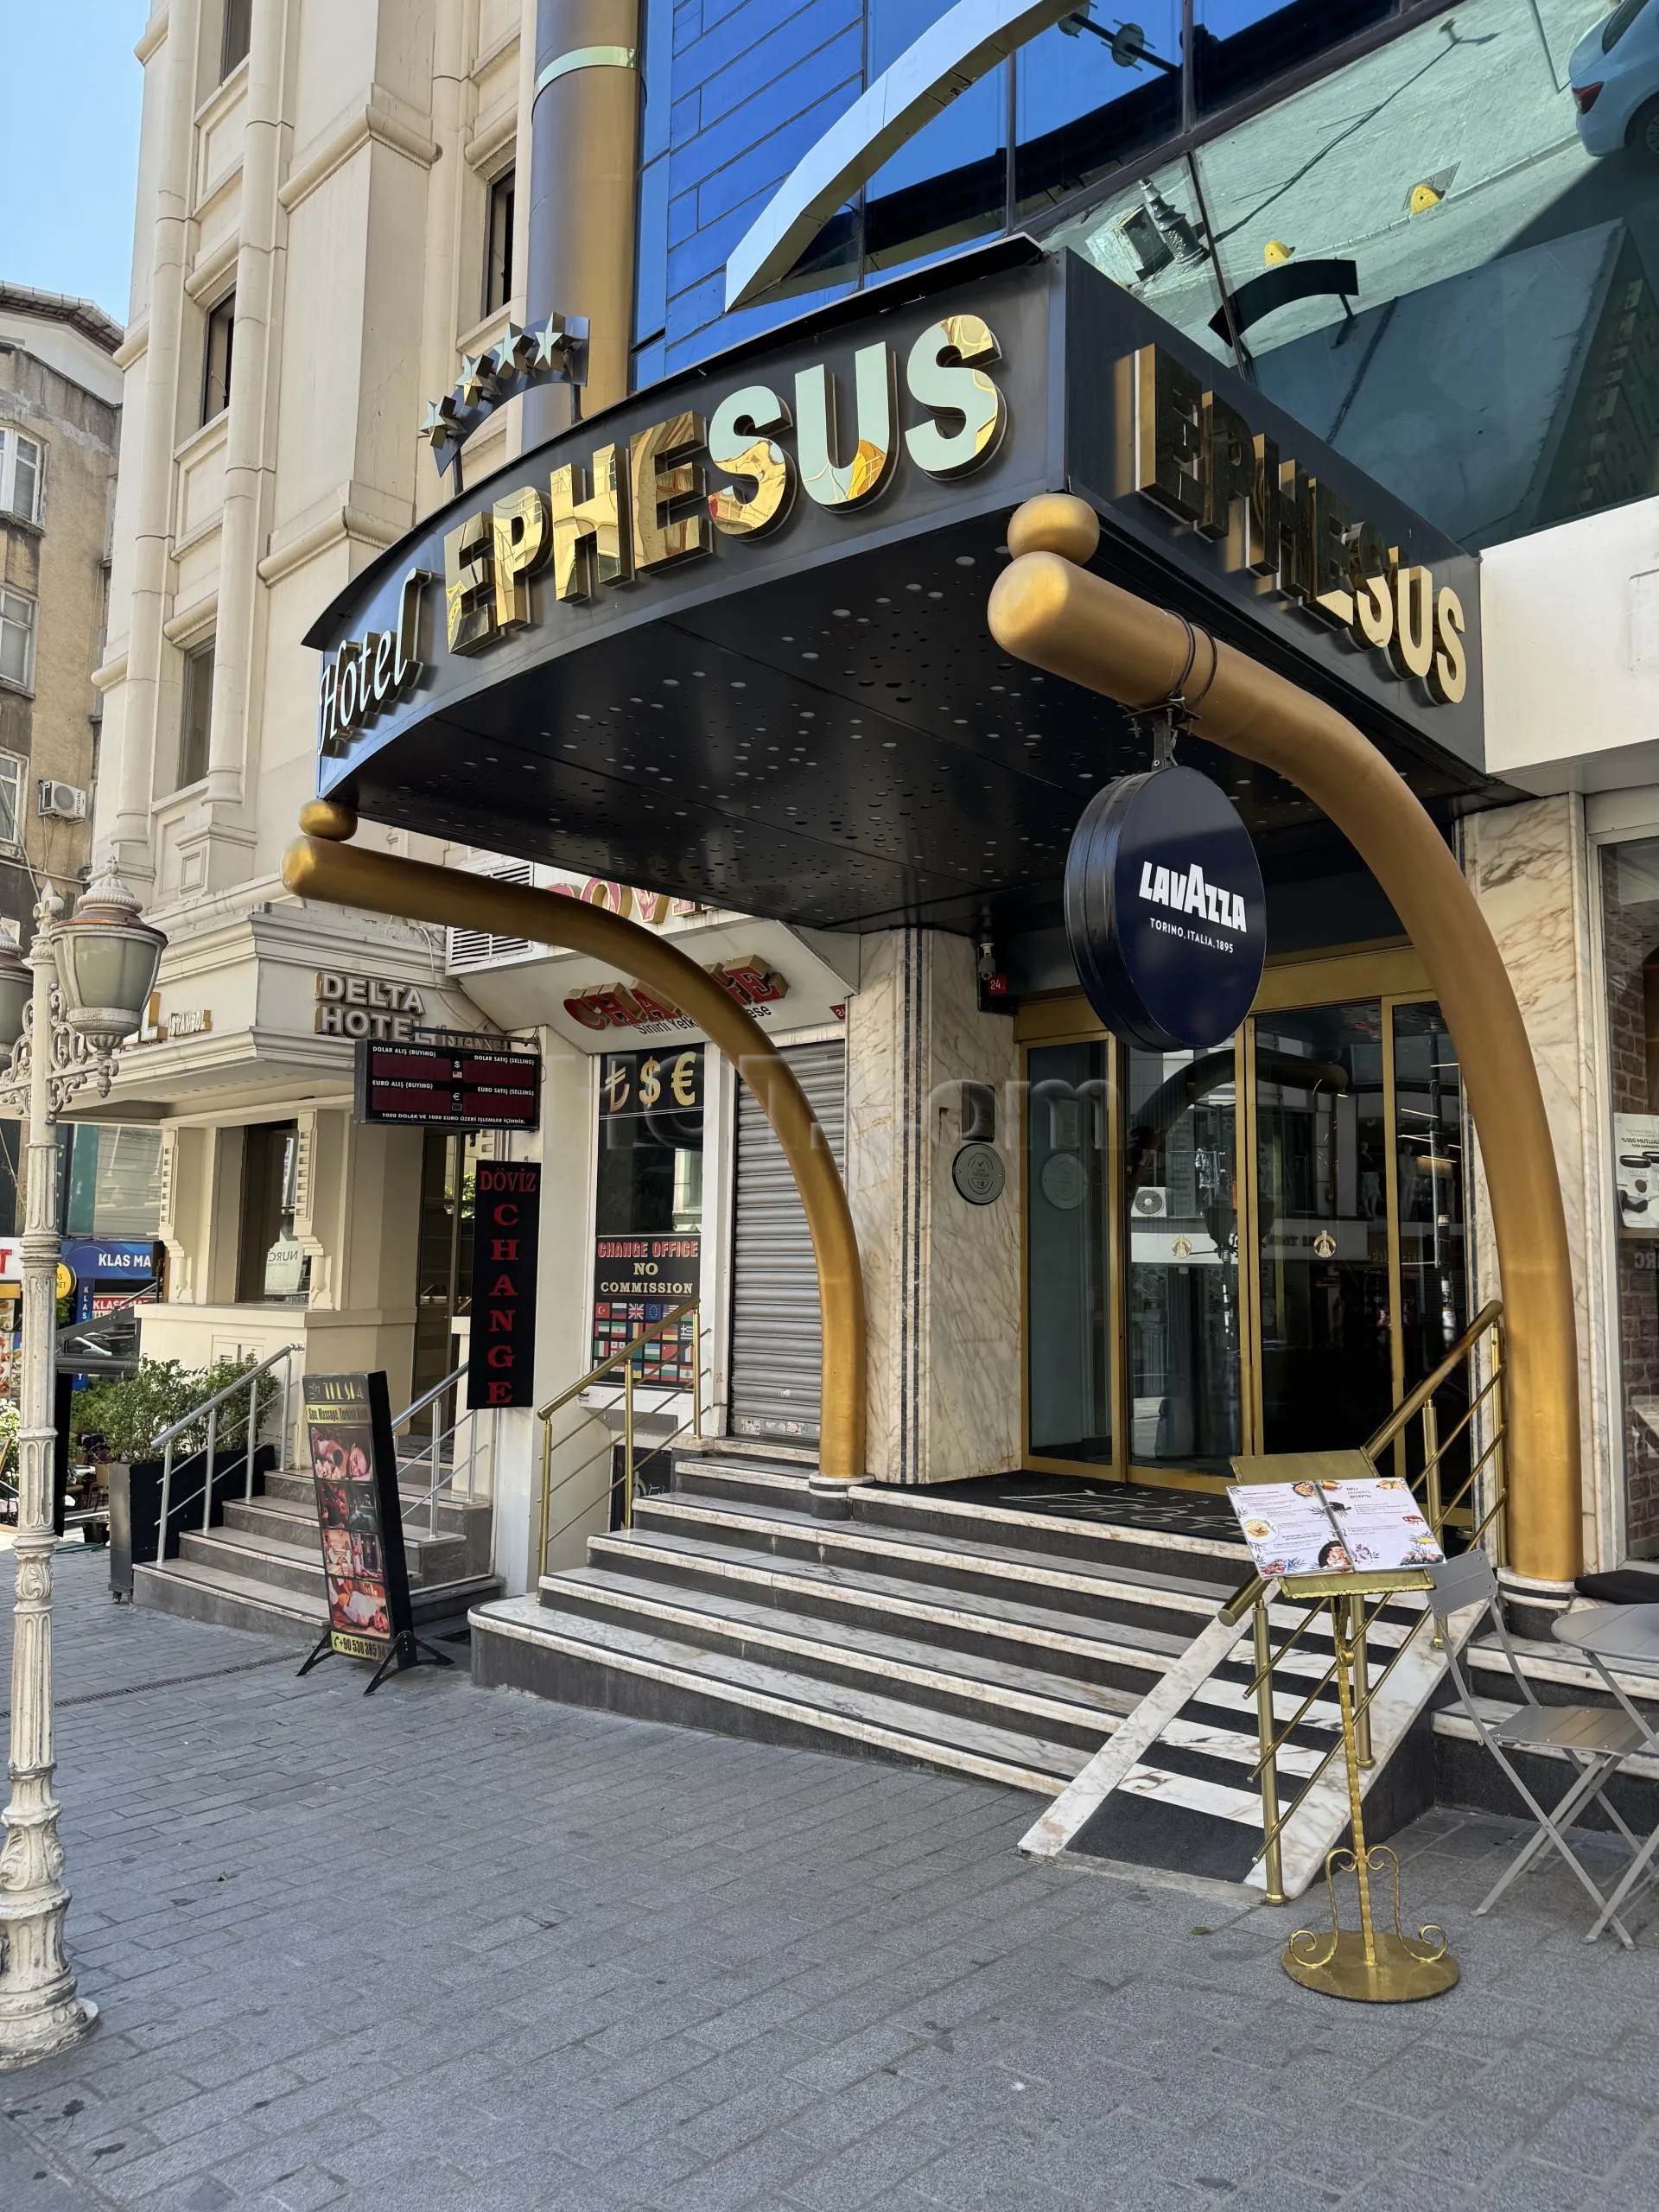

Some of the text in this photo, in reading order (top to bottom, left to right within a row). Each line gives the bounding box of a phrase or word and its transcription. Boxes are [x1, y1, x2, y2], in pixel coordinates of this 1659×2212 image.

[1135, 342, 1467, 706] EPHESUS
[318, 314, 1007, 759] Hotel EPHESUS
[1139, 861, 1247, 933] LAVAZZA
[1216, 939, 1234, 953] 1895
[317, 972, 426, 1014] DELTA
[563, 954, 789, 1030] CHAE
[315, 1006, 432, 1046] HOTEL
[409, 1049, 436, 1058] (BUYING)
[509, 1057, 535, 1065] (SELLING)
[509, 1088, 534, 1096] (SELLING)
[480, 1167, 536, 1192] DÖVİZ
[597, 1241, 698, 1257] CHANGE OFFICE
[99, 1253, 152, 1268] KLAS MA
[633, 1262, 658, 1275] NO
[601, 1282, 692, 1294] COMMISSION
[486, 1204, 519, 1405] CHANGE
